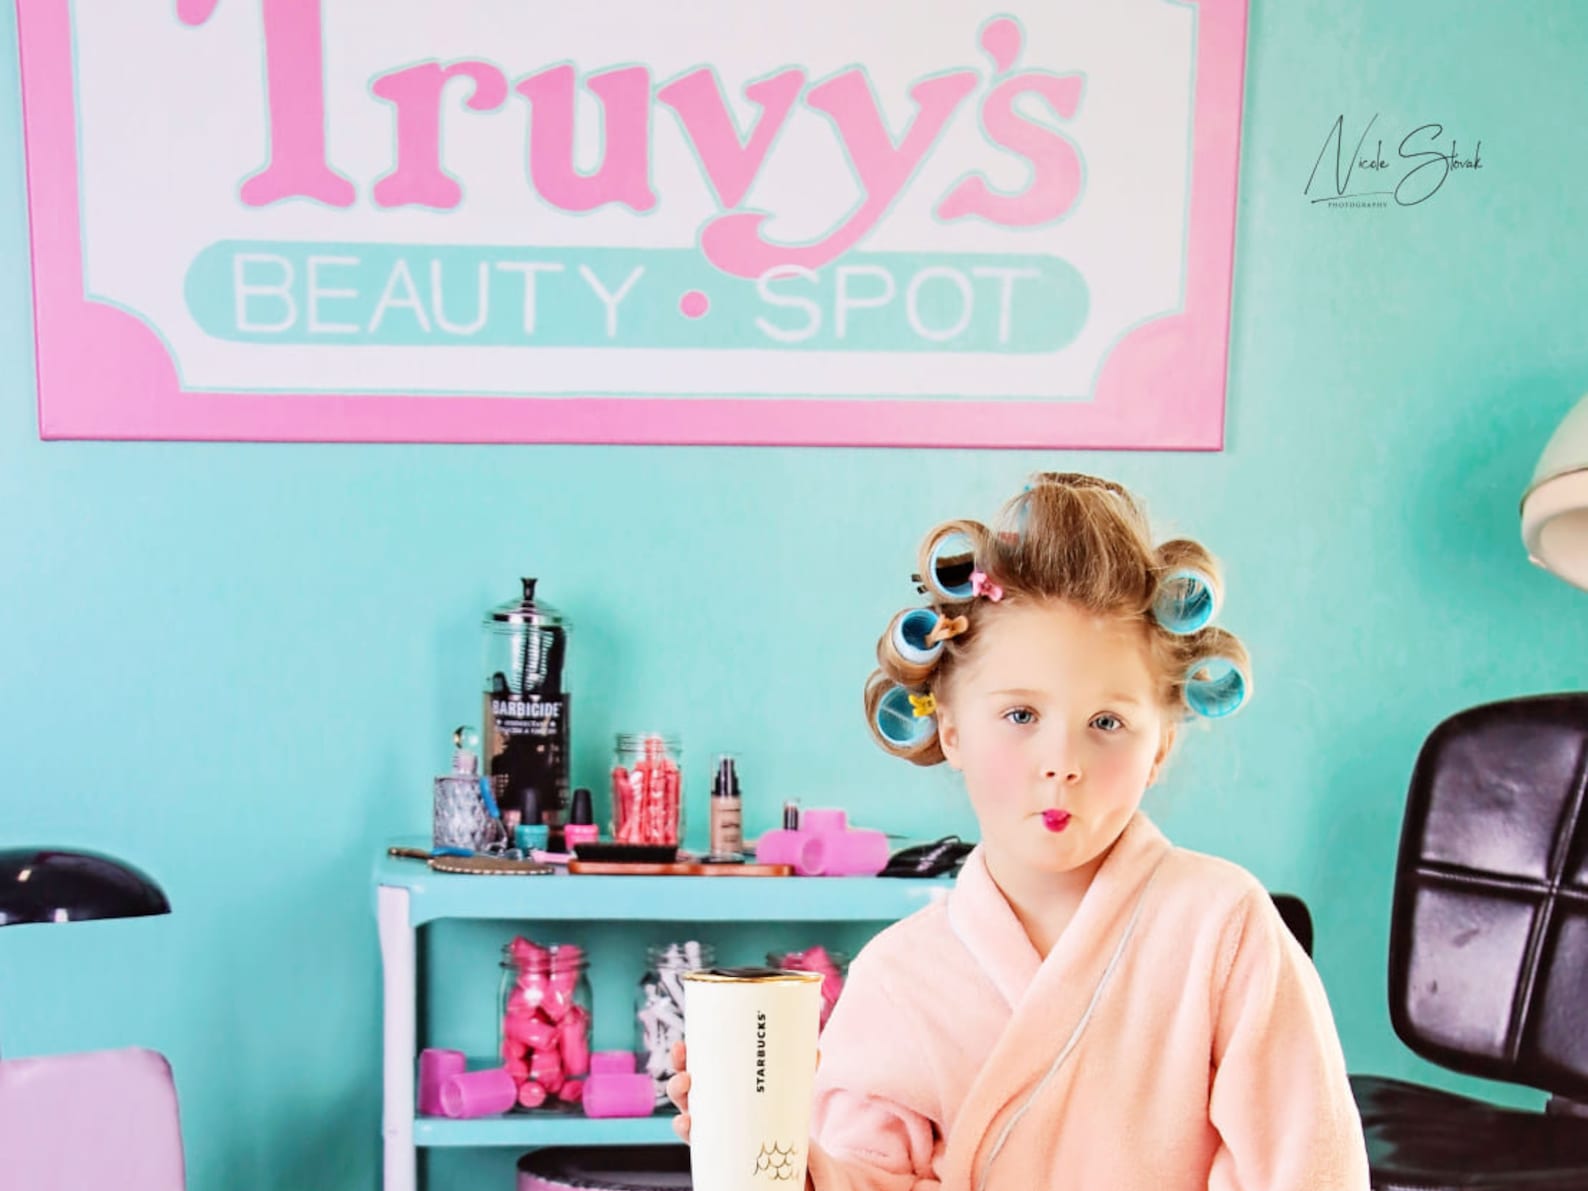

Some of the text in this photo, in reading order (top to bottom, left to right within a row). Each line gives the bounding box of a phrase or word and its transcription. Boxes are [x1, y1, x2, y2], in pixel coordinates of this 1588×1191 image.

[233, 254, 1041, 343] BEAUTY SPOT
[492, 700, 561, 717] BARBICIDE
[756, 1012, 766, 1093] STARBUCKS
